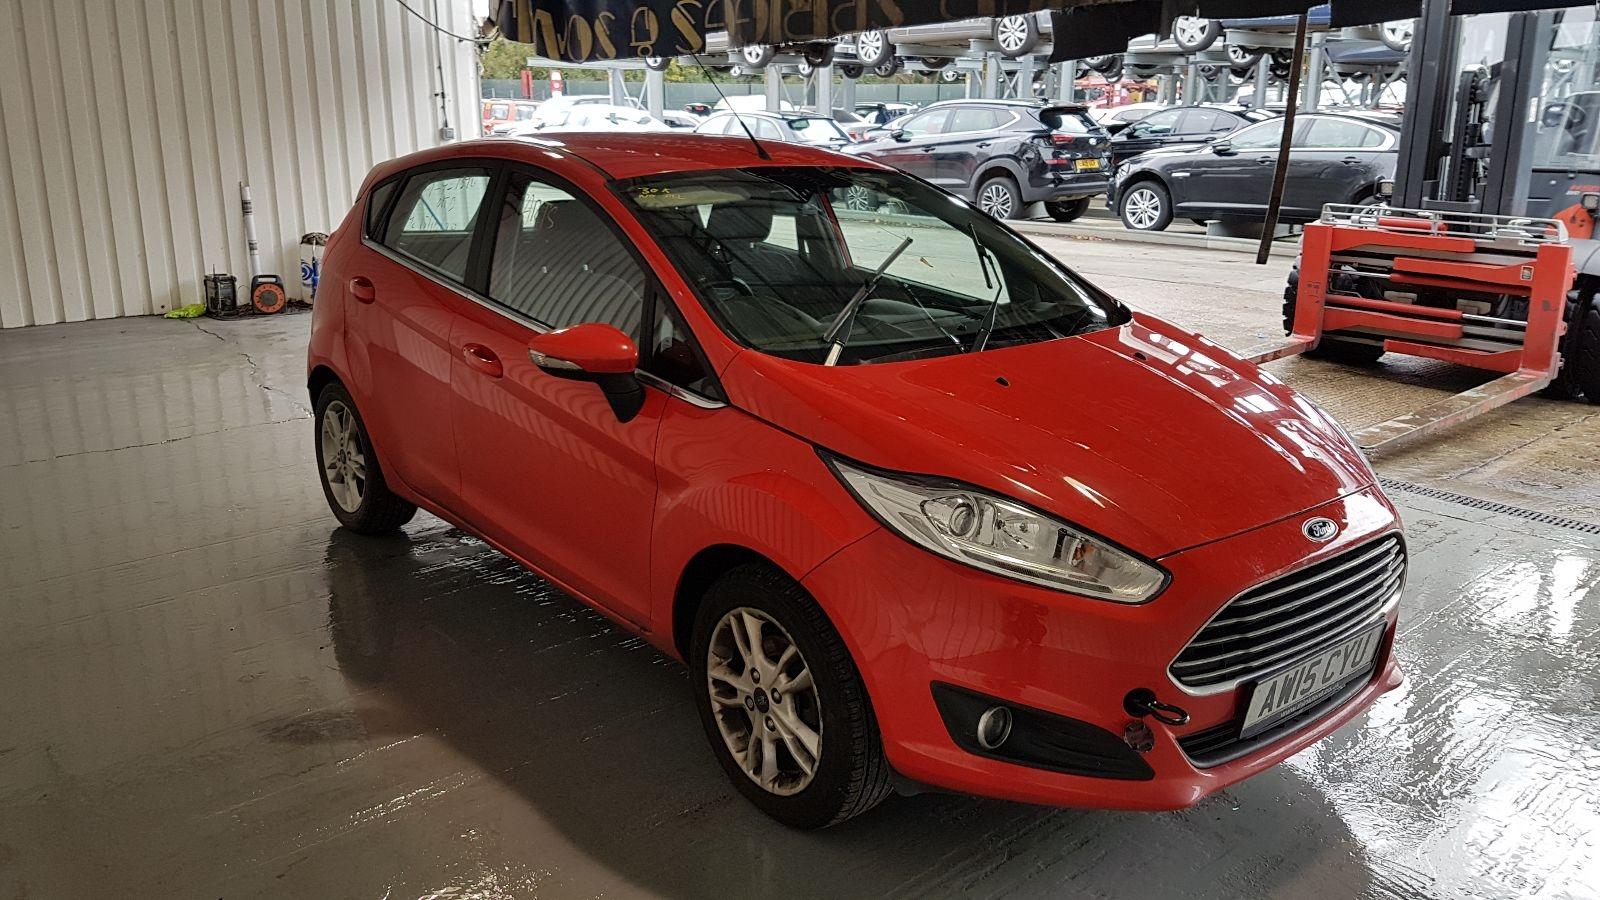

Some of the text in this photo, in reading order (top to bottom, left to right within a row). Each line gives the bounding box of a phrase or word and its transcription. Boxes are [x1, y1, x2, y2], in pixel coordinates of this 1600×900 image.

[1311, 522, 1332, 537] Ford
[1258, 658, 1323, 718] AW15
[1321, 632, 1374, 683] CYU
